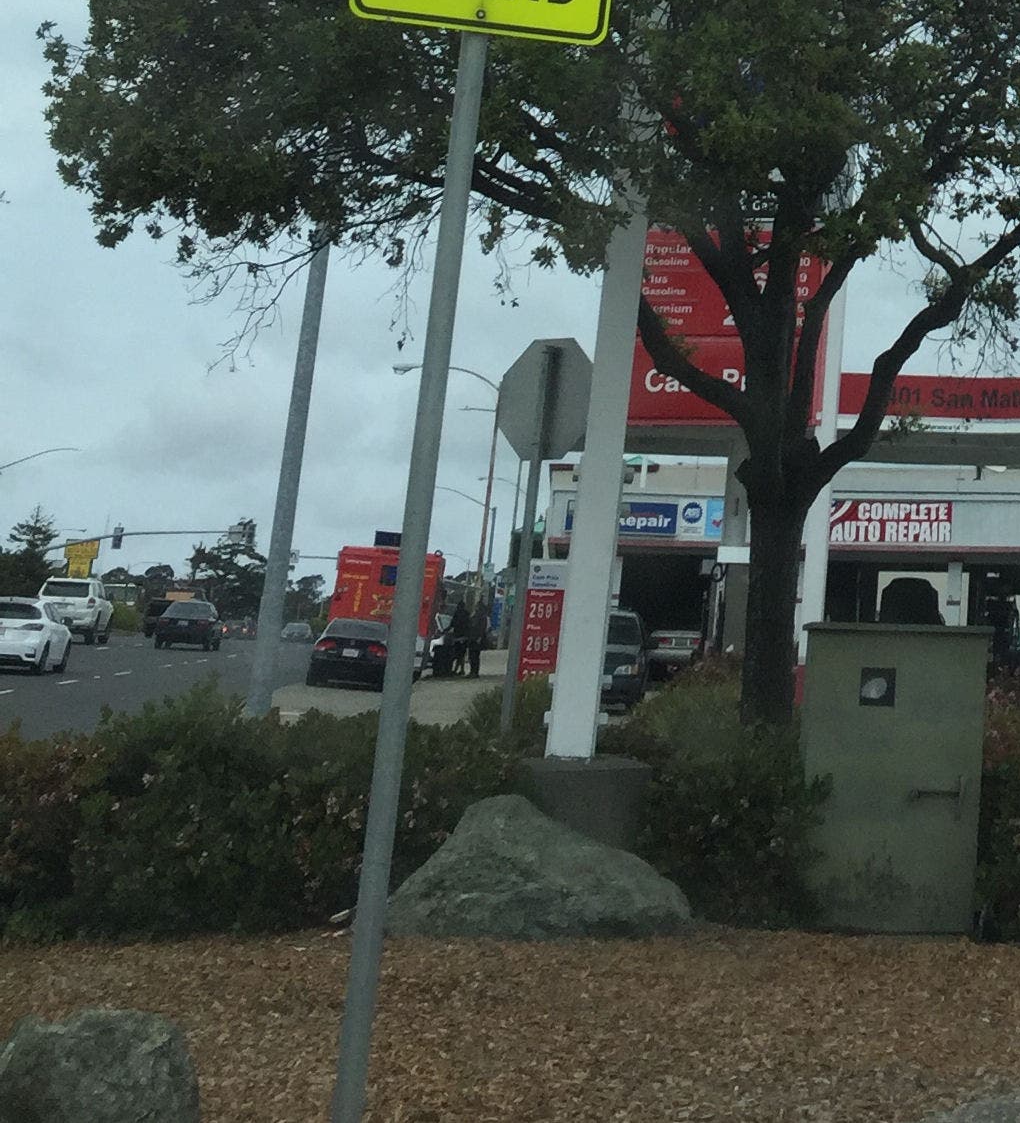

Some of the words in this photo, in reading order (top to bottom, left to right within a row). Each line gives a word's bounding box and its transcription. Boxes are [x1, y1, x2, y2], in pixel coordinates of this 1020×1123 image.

[642, 275, 668, 284] lus
[641, 287, 686, 296] Gasoline
[653, 304, 692, 314] emium
[931, 387, 974, 408] San
[857, 502, 949, 521] COMPLETE
[830, 521, 881, 542] AUTO
[884, 522, 952, 543] REPAIR
